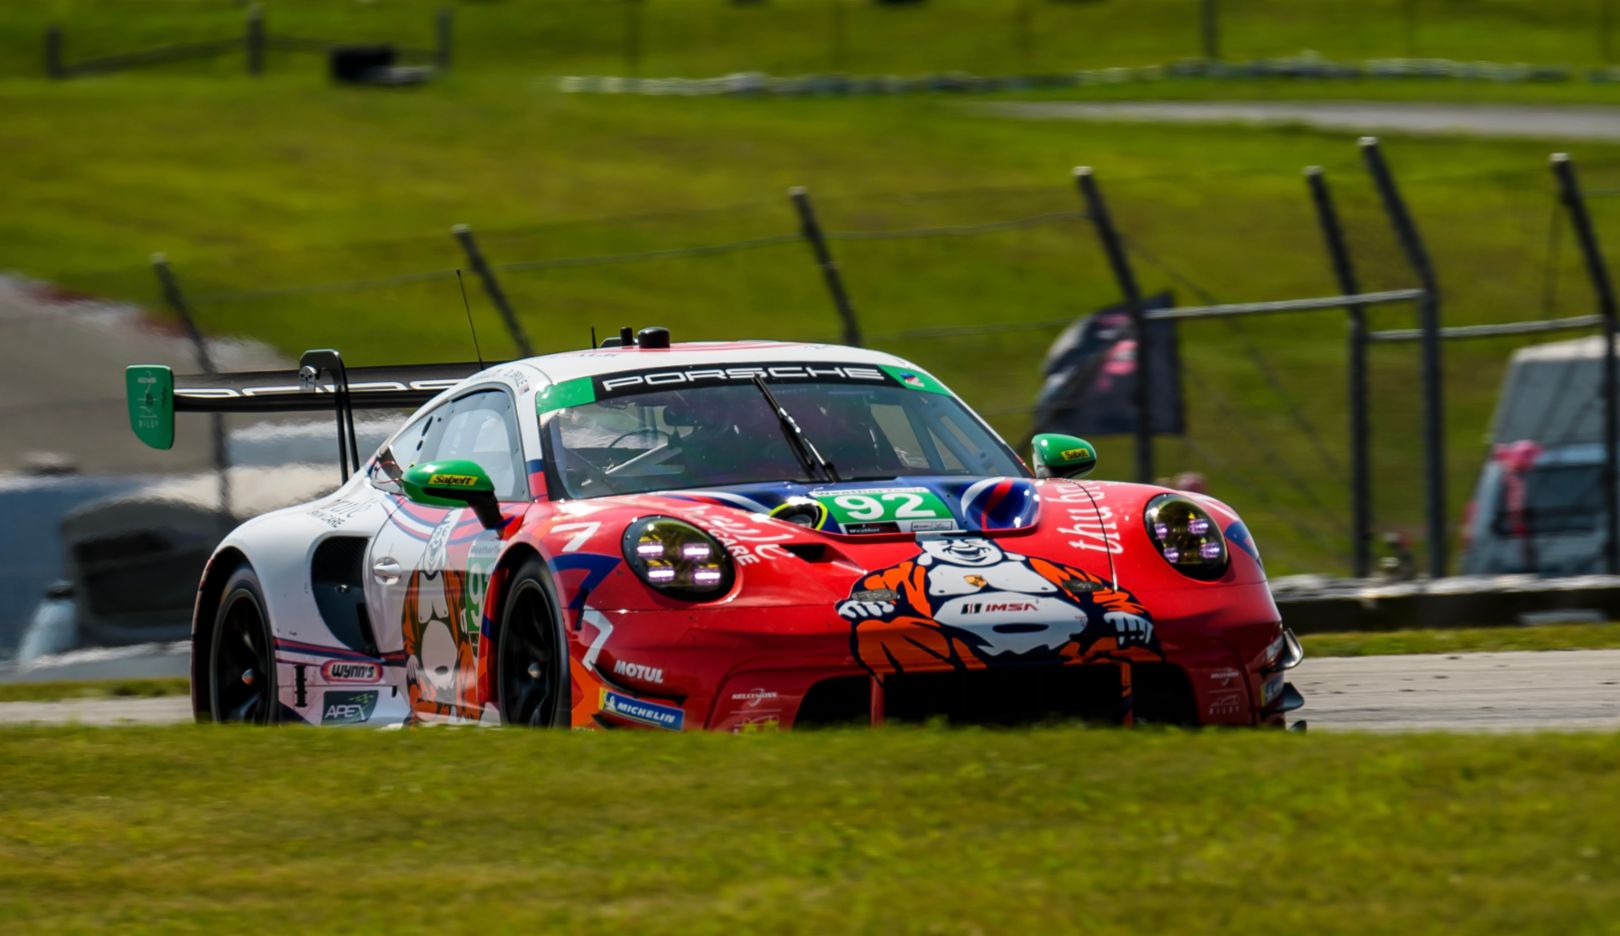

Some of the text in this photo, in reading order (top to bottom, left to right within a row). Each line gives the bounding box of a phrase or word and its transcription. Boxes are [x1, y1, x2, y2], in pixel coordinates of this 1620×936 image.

[602, 366, 885, 392] PORSCHE
[834, 492, 937, 521] 92
[708, 528, 760, 567] CARE
[985, 602, 1039, 613] IMSA
[613, 660, 665, 684] MOTUL
[324, 704, 367, 721] APEX
[617, 702, 677, 724] MICHELIN
